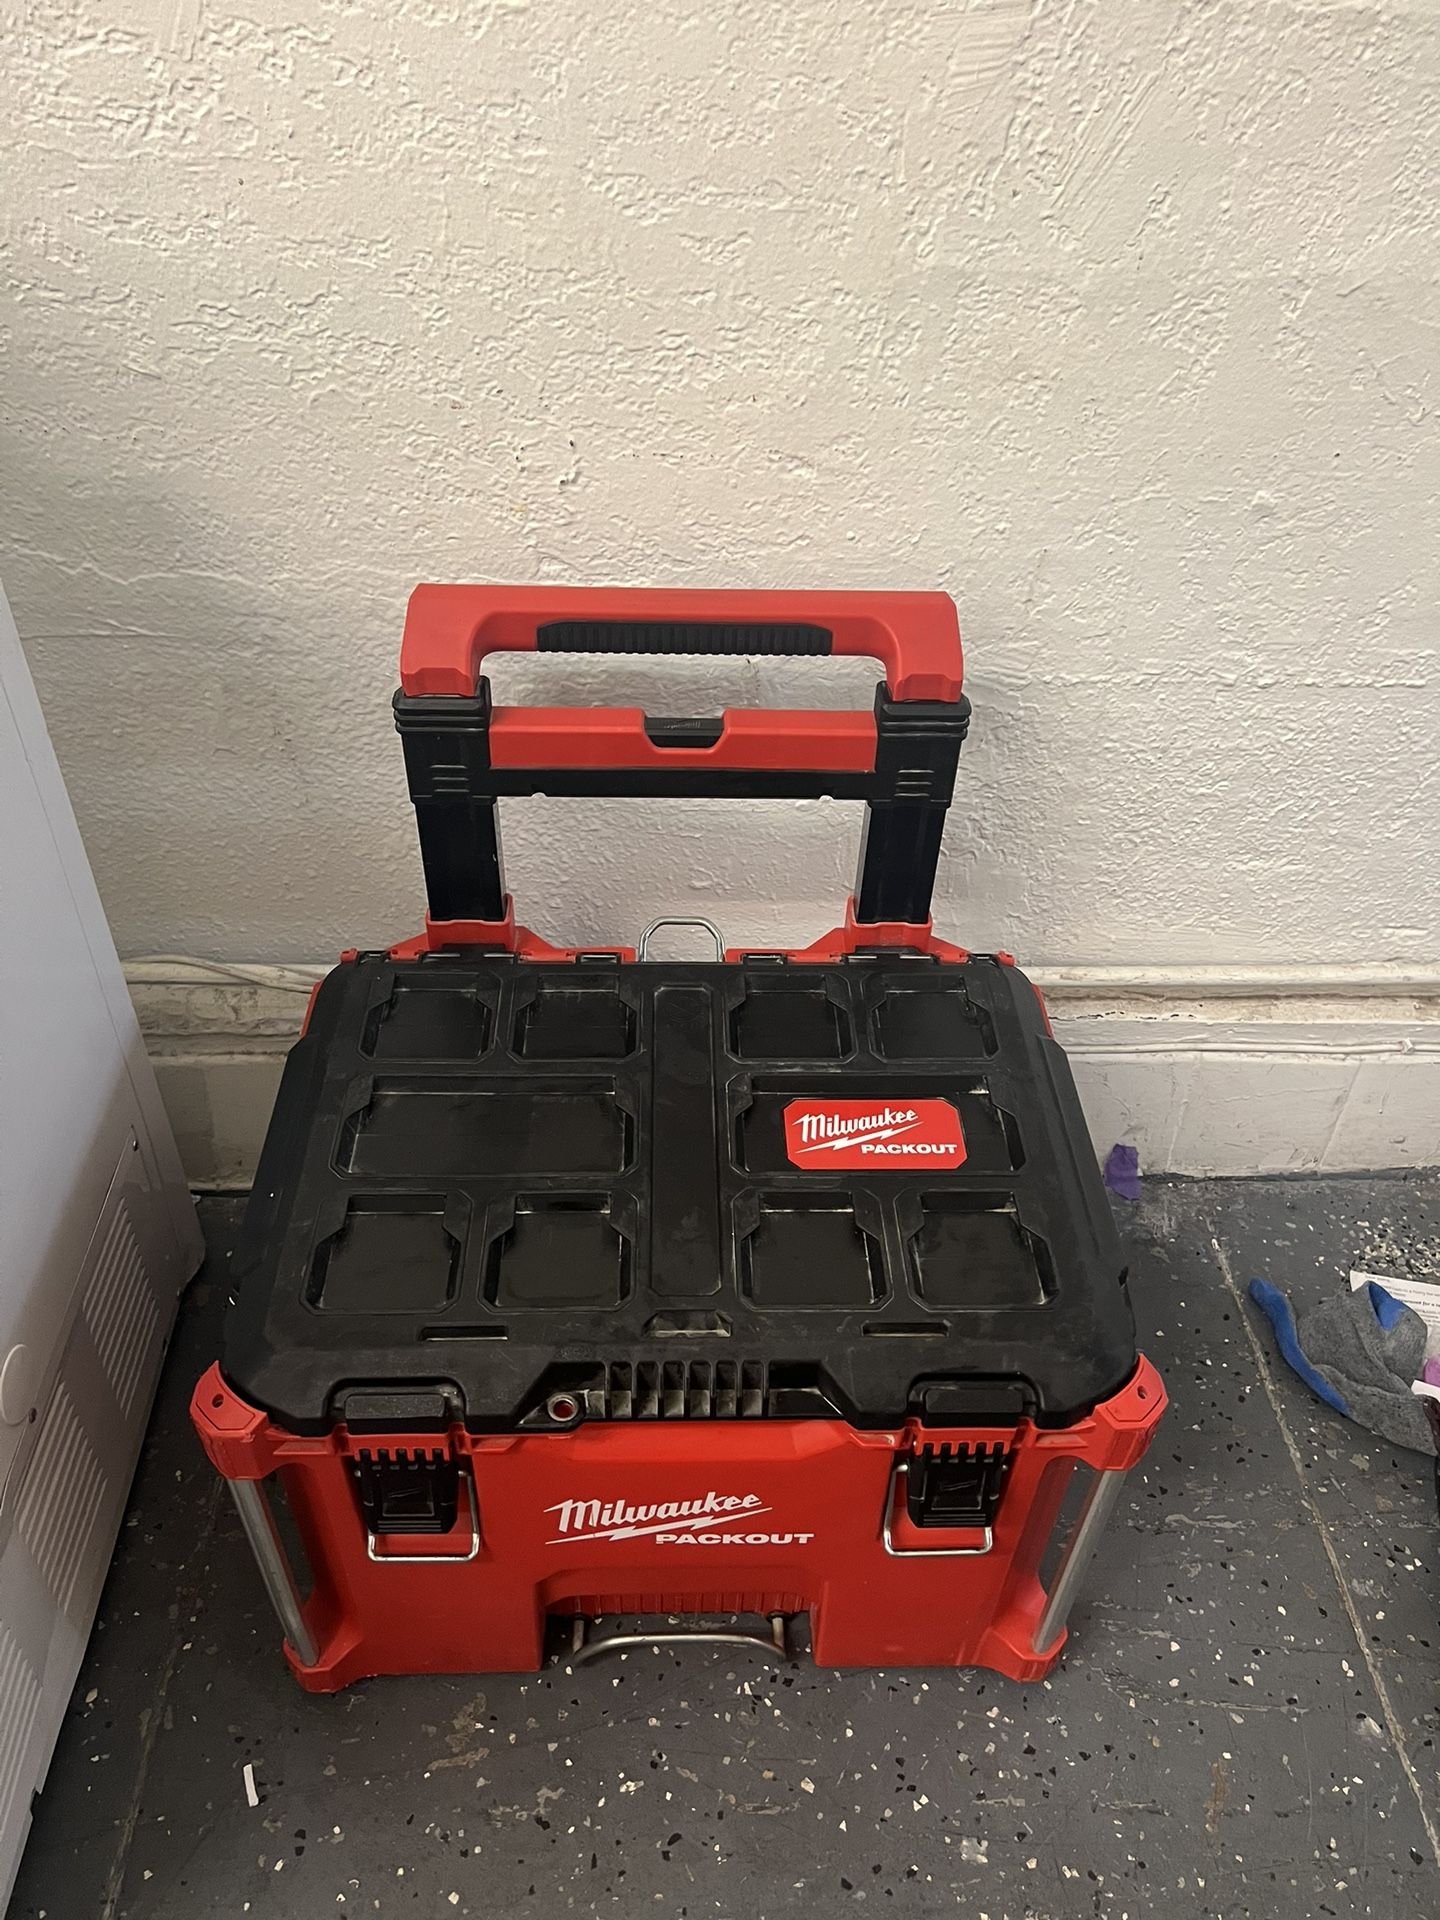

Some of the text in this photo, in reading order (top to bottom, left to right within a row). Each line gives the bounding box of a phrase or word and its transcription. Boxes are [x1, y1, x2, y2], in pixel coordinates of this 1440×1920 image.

[792, 1107, 919, 1143] Milwaukee
[861, 1143, 957, 1155] PACKOUT
[543, 1491, 763, 1533] Milwaukee
[655, 1532, 815, 1545] PACKOUT
